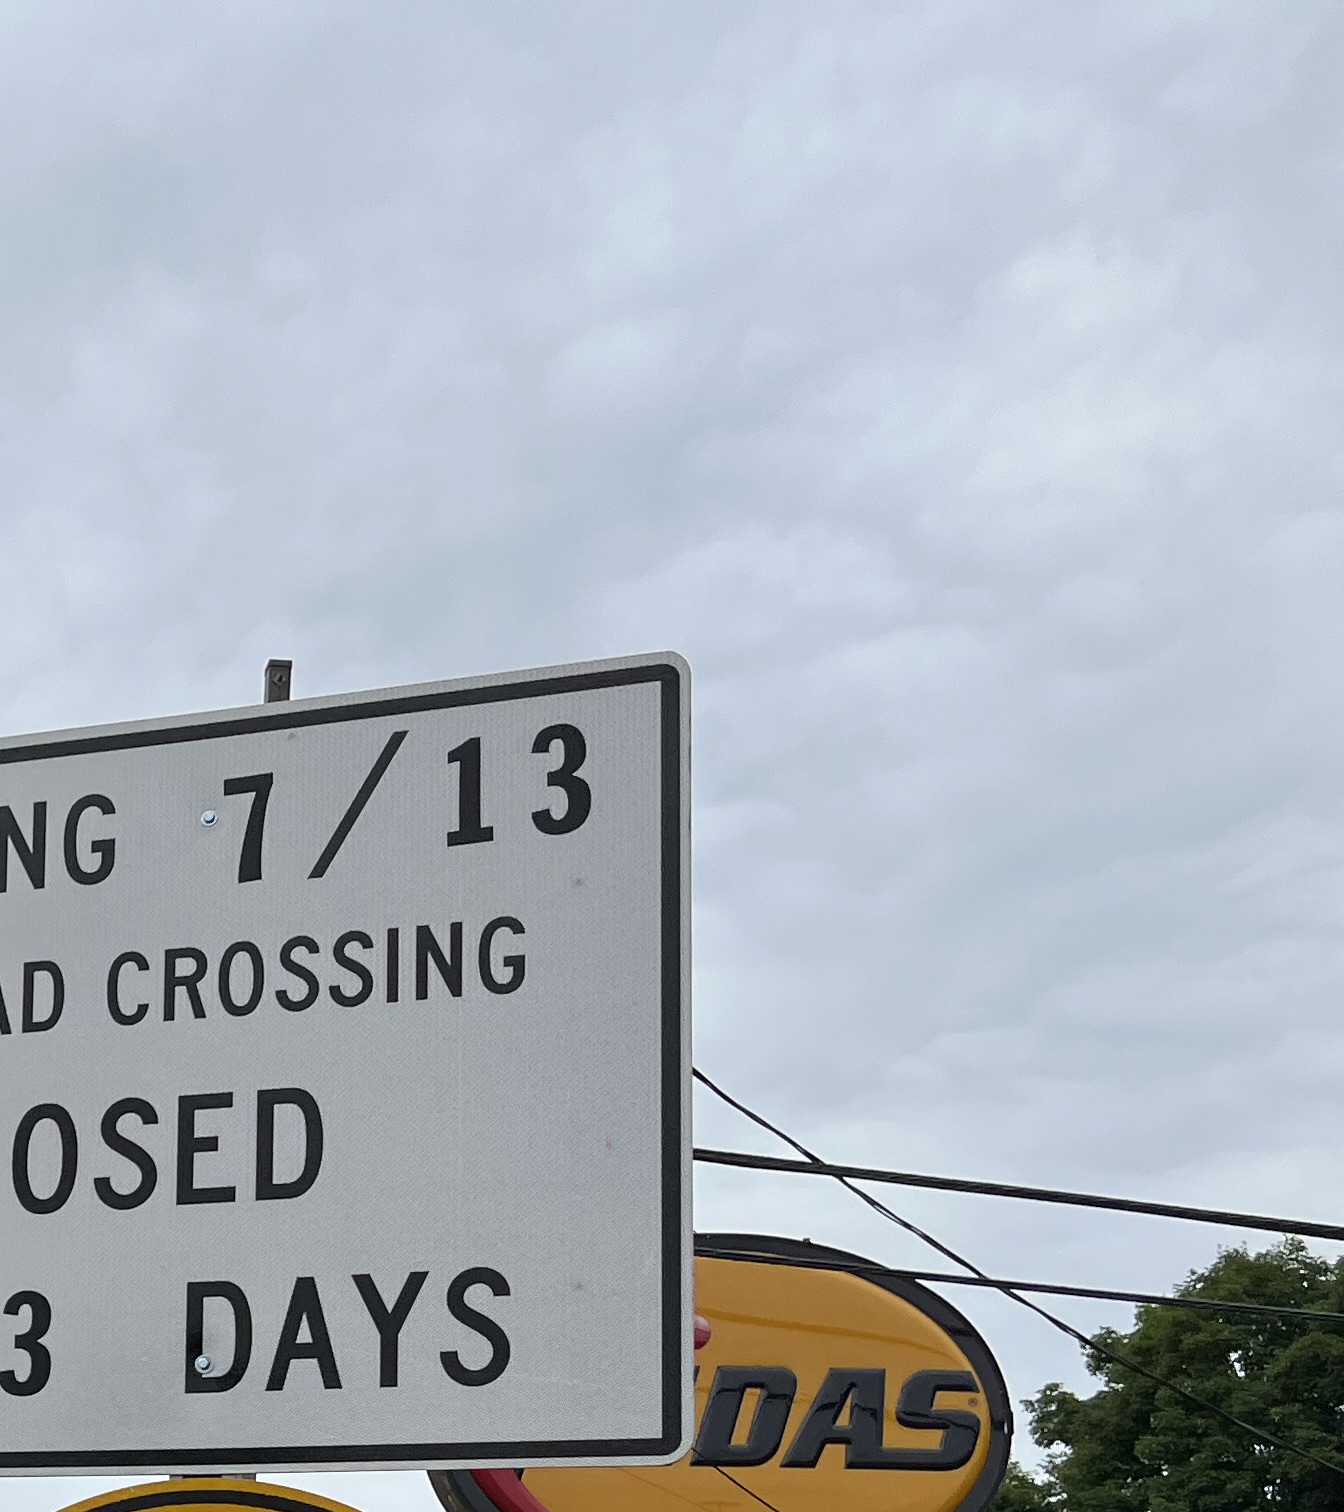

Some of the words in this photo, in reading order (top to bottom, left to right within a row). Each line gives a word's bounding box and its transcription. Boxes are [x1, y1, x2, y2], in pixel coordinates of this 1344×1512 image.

[106, 915, 528, 1027] CROSSING
[184, 1265, 513, 1395] DAYS
[692, 1364, 982, 1471] DAS
